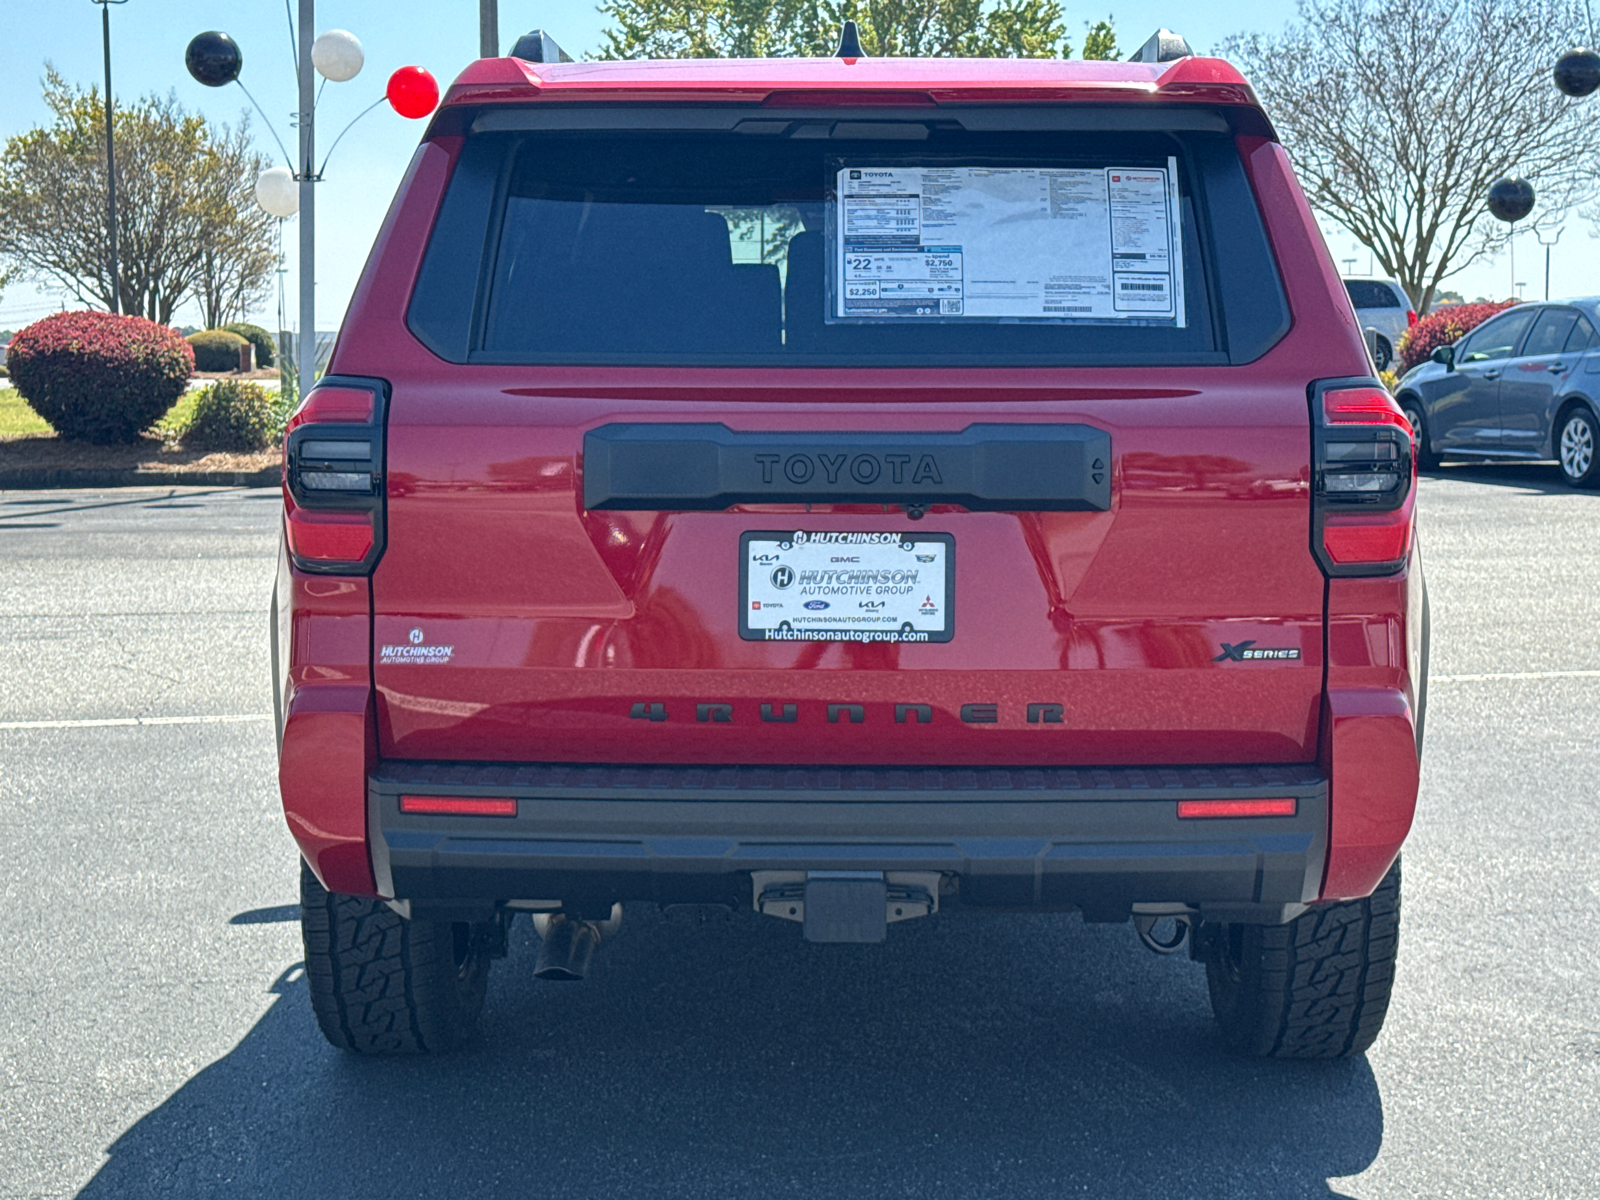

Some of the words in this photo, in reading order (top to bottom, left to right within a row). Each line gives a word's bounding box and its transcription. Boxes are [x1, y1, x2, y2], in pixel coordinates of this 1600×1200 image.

[852, 258, 872, 270] 22
[925, 259, 953, 268] $2,750
[849, 288, 877, 296] $2,250
[754, 453, 943, 485] TOYOTA
[810, 532, 902, 545] HUTCHINSON
[798, 569, 919, 585] HUTCHINSON
[800, 585, 872, 595] AUTOMOTIVE
[875, 585, 914, 595] GROUP
[807, 601, 826, 610] Ford
[765, 628, 928, 643] Hutchinsonautogroup.com
[381, 646, 452, 656] HUTCHINSON
